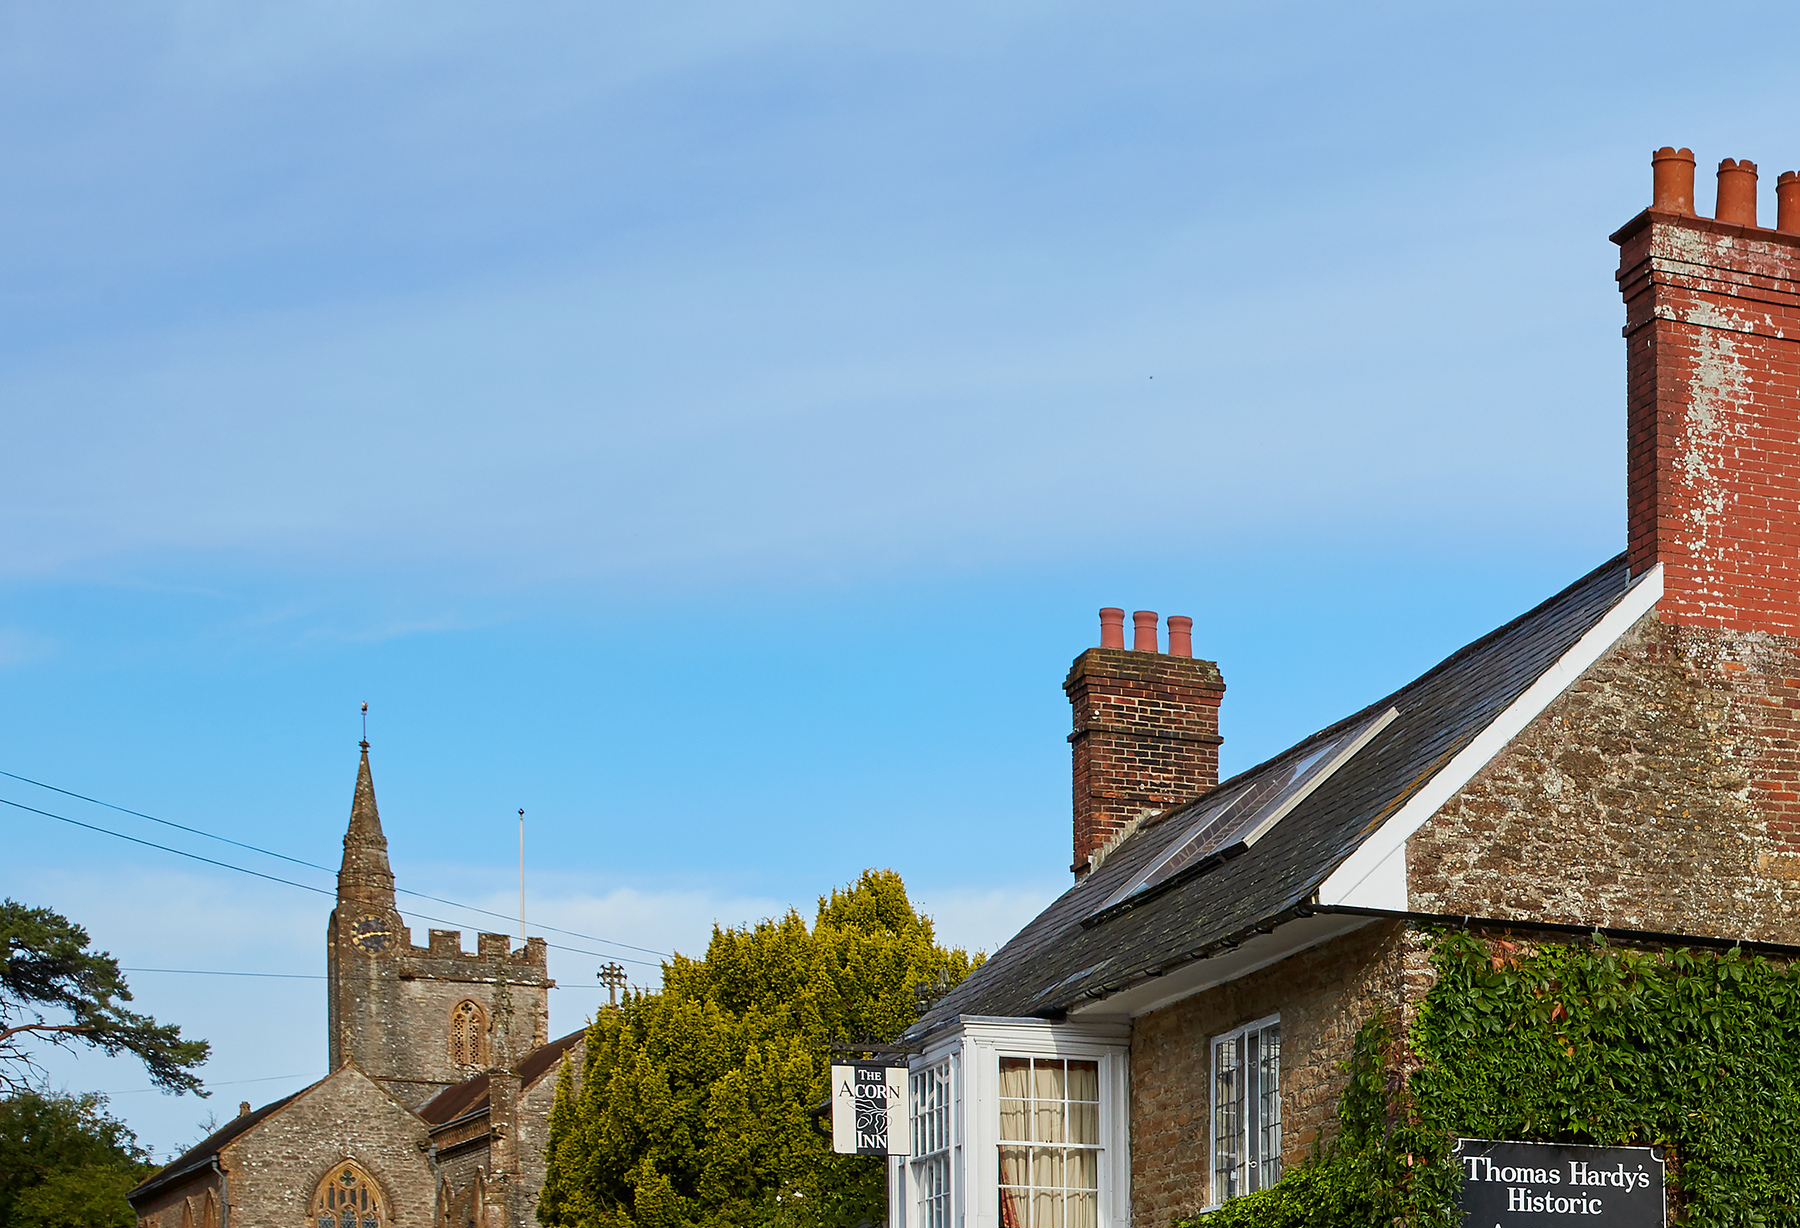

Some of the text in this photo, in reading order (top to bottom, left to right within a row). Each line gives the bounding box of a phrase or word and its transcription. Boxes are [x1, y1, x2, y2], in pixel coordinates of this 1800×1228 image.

[858, 1069, 882, 1081] THE
[839, 1080, 900, 1099] ACORN
[856, 1130, 888, 1149] INN
[1462, 1155, 1650, 1194] Thomas Hardy's
[1506, 1187, 1603, 1216] Historic
